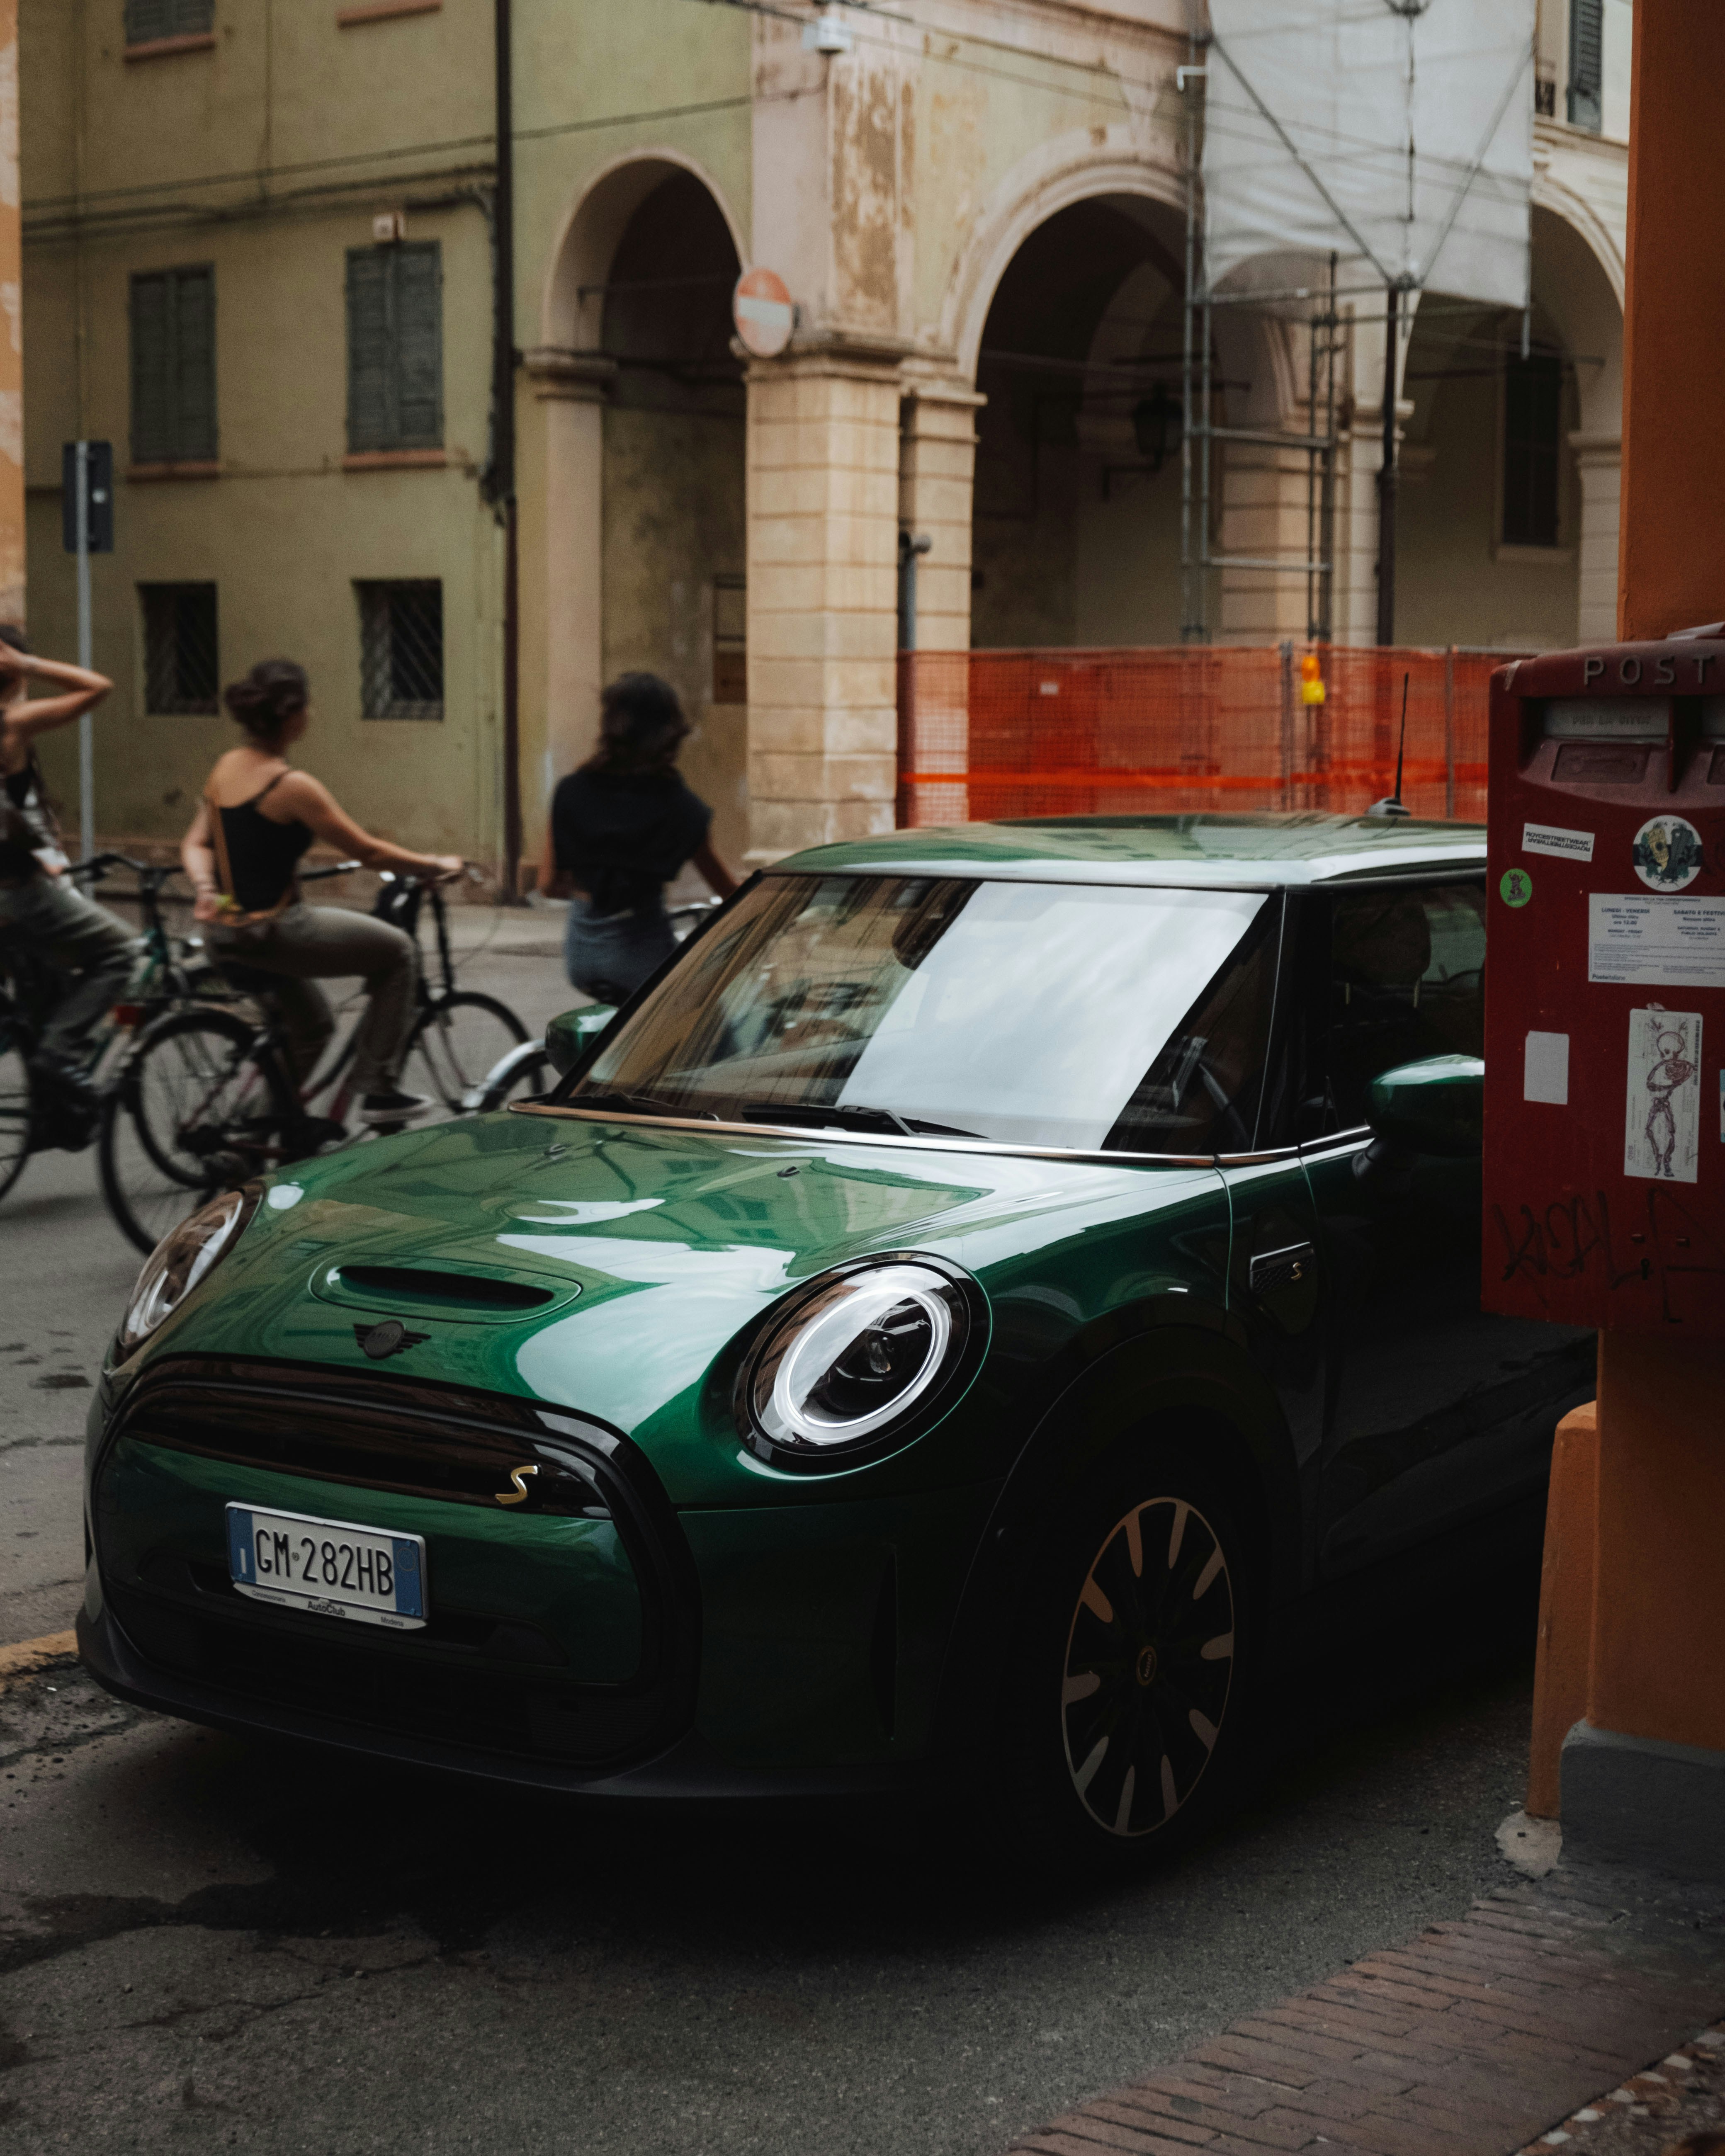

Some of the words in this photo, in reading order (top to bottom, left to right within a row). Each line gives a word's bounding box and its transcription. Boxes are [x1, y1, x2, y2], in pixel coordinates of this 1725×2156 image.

[1583, 653, 1715, 685] POST
[495, 1464, 539, 1505] S
[307, 1600, 345, 1617] AutoClub
